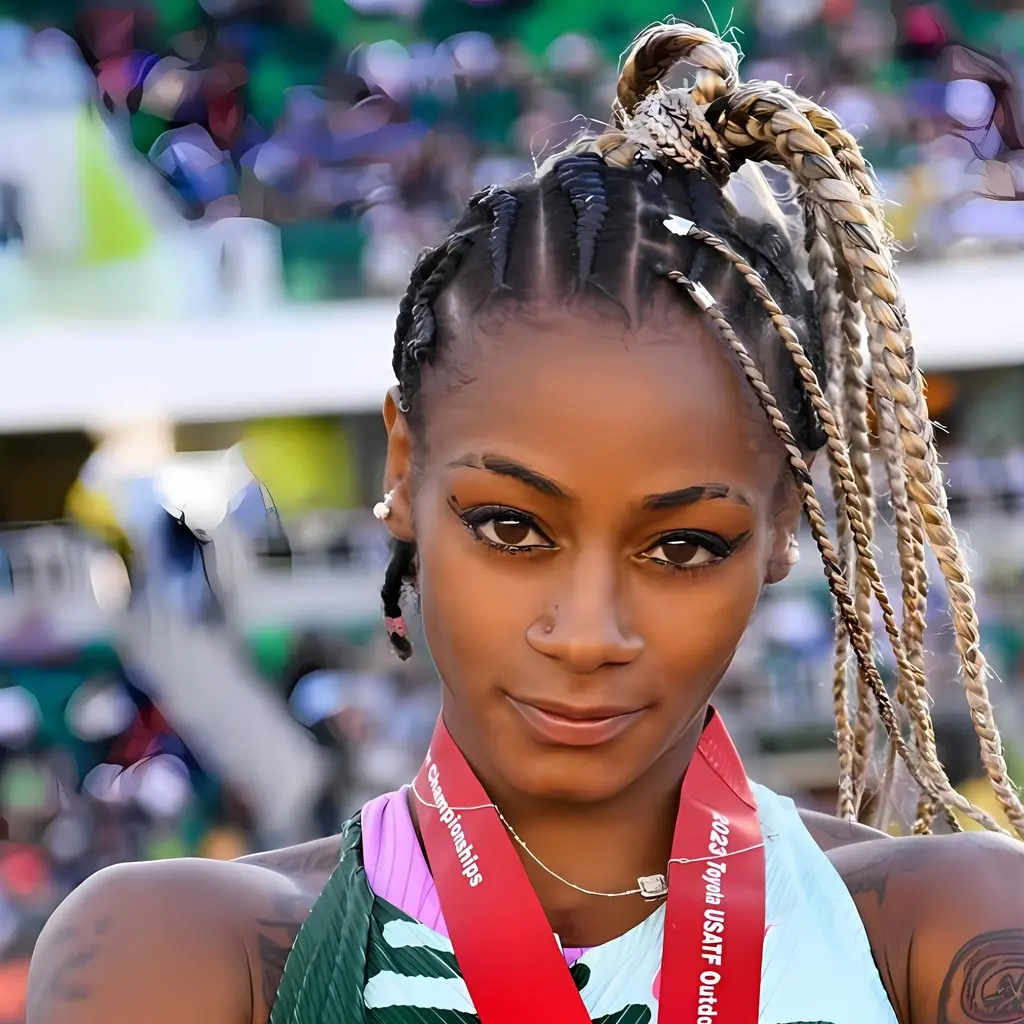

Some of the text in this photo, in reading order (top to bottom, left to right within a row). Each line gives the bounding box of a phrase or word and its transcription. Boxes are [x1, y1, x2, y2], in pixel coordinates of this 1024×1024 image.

[428, 763, 483, 888] Championships
[708, 811, 730, 857] 2023
[701, 908, 726, 966] USATF
